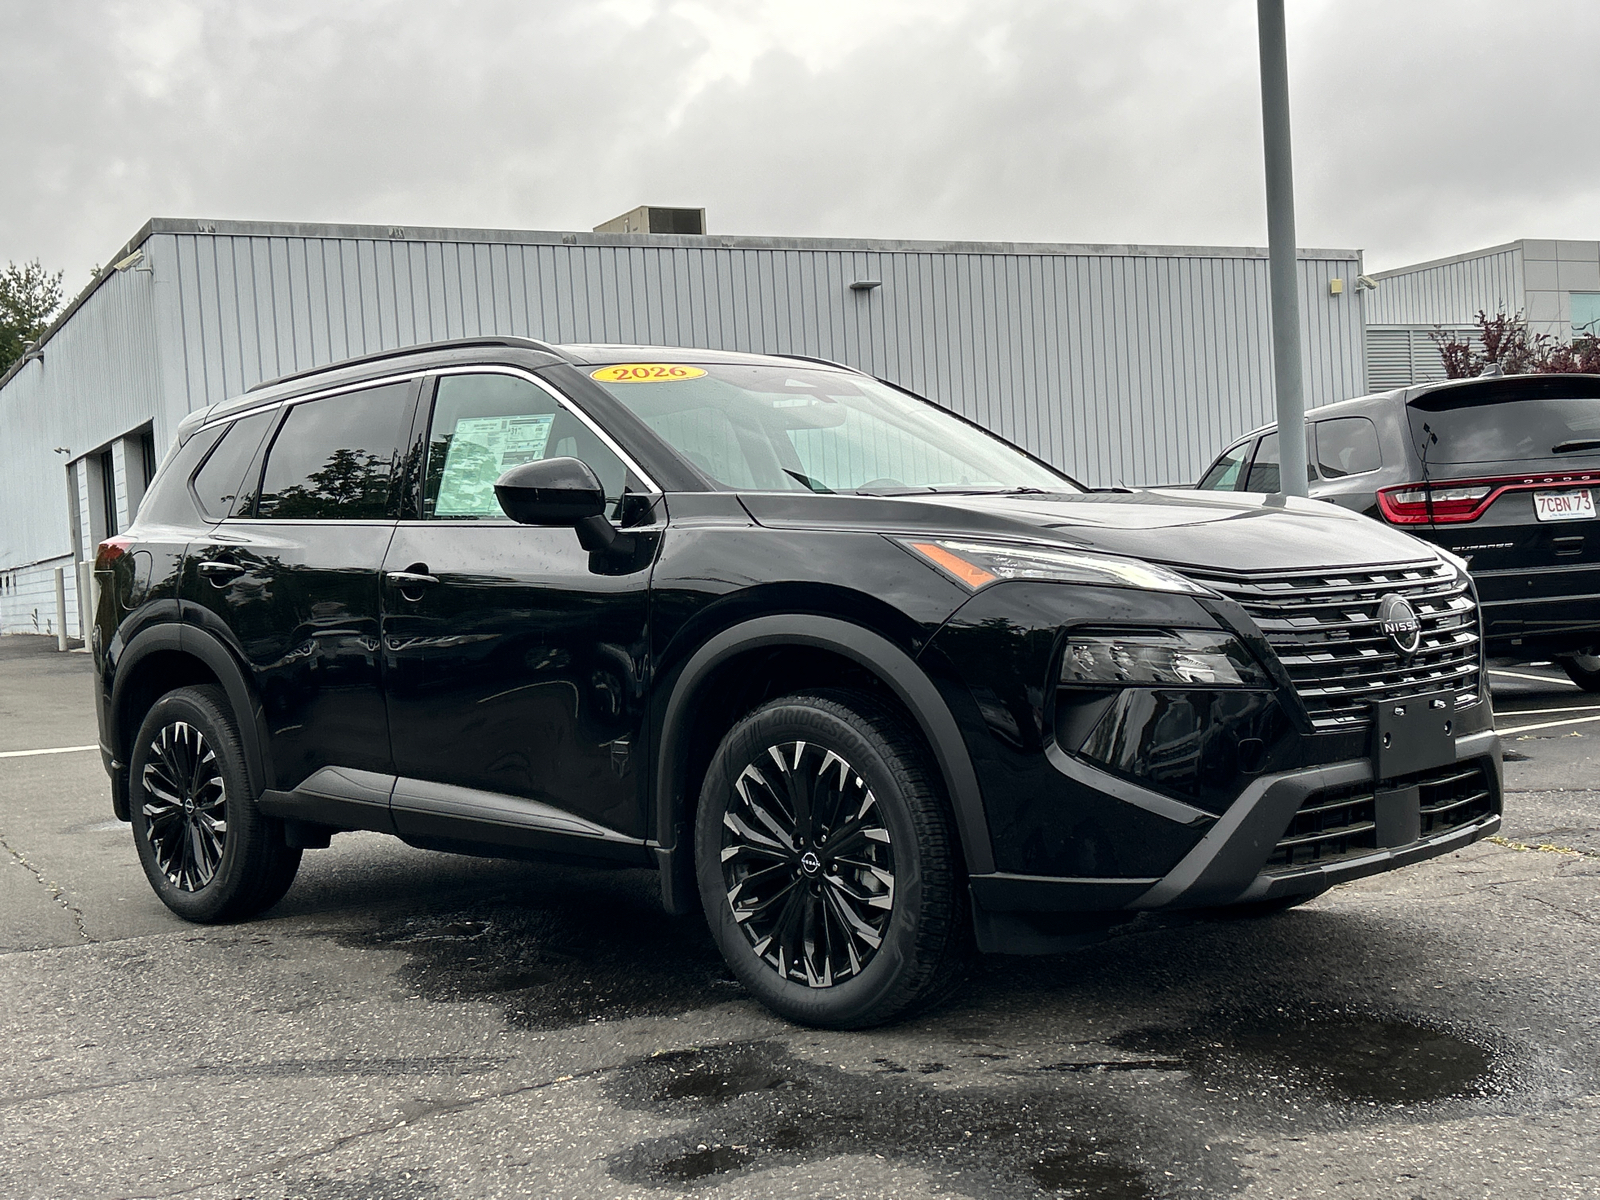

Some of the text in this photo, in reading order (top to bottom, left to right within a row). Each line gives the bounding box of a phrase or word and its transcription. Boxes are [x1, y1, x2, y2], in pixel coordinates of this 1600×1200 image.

[613, 366, 687, 380] 2026
[1538, 495, 1592, 513] 7CBN 73
